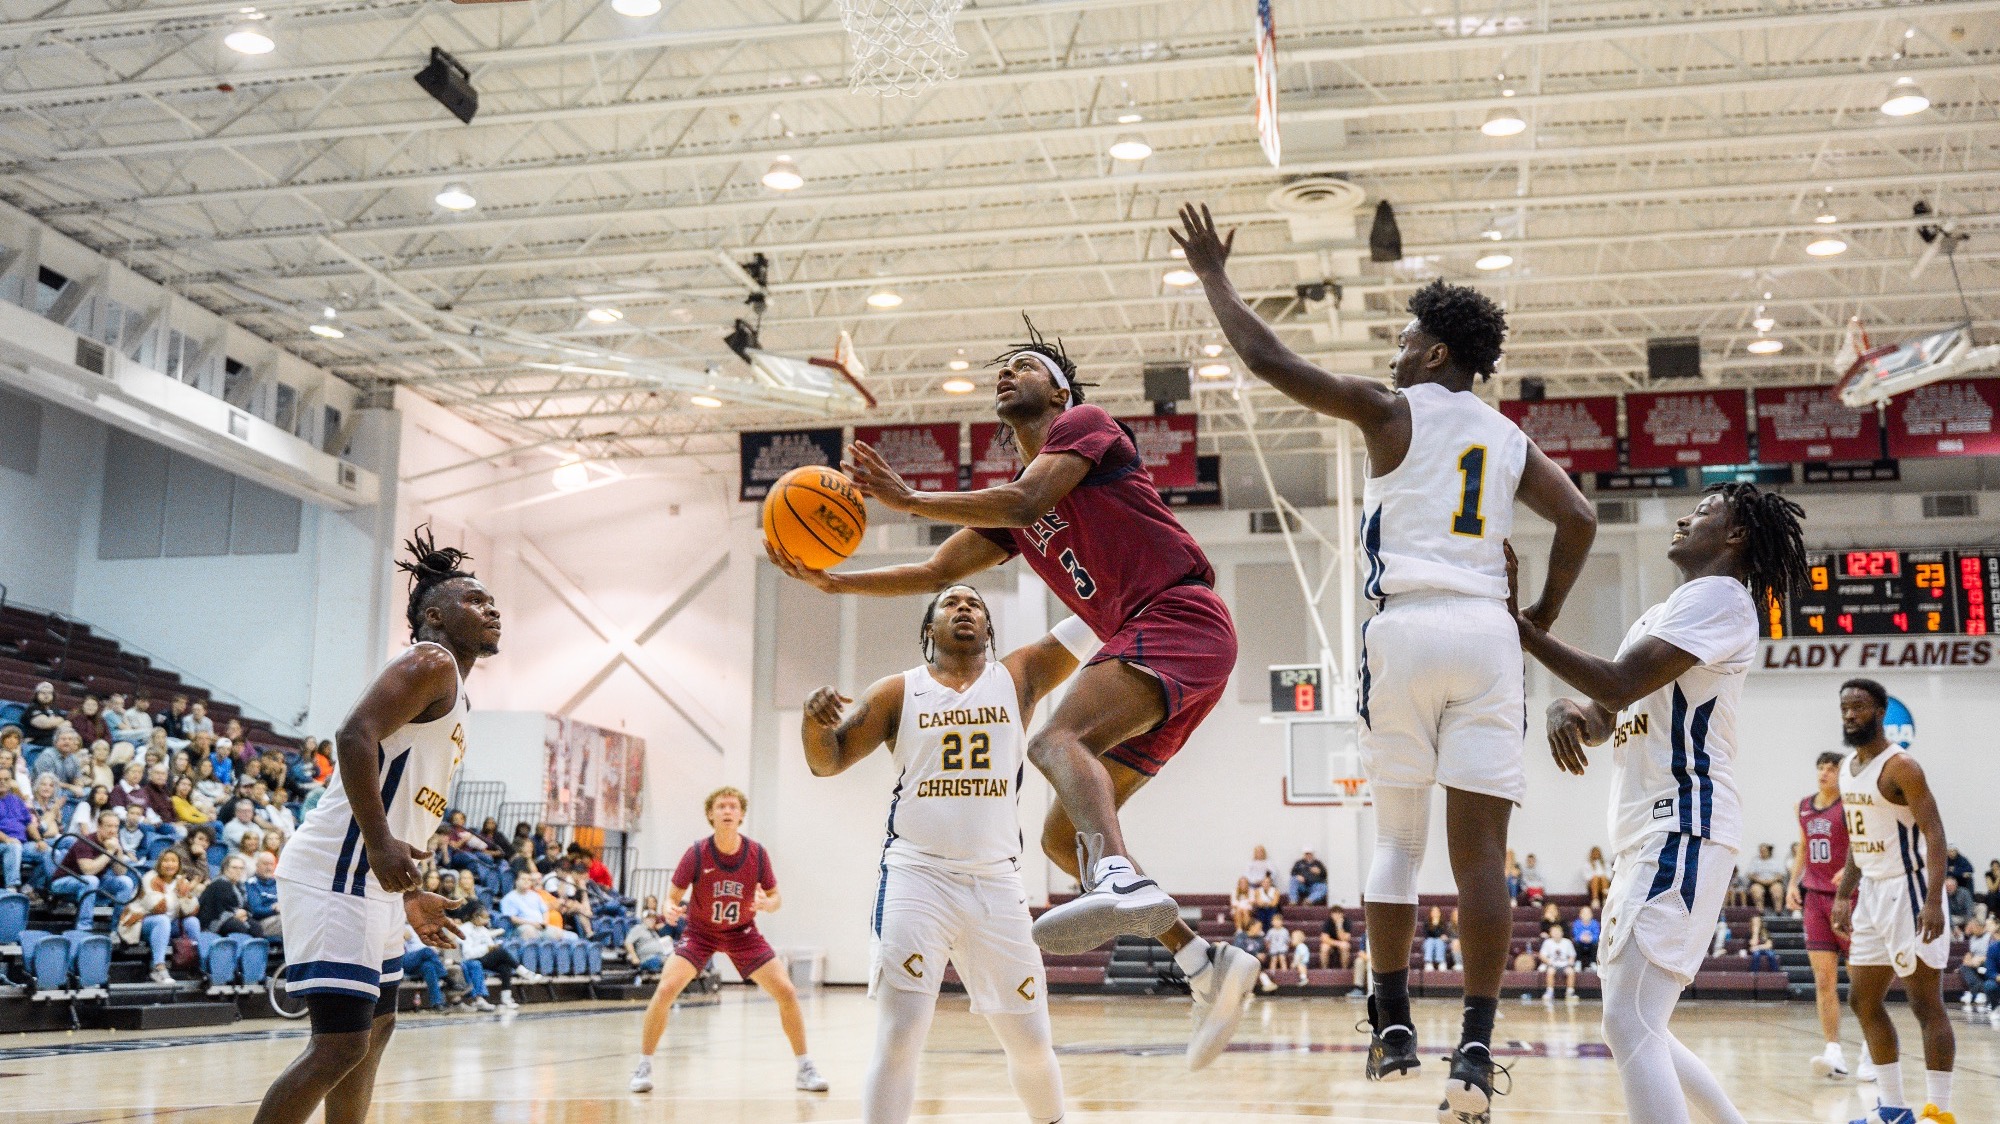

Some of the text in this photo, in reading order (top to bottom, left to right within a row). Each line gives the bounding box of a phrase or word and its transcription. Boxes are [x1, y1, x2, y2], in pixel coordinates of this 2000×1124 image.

[1450, 444, 1487, 539] 1
[1058, 546, 1097, 600] 3
[1915, 563, 1946, 588] 23
[1808, 613, 1825, 634] 4
[1837, 612, 1853, 634] 4
[1893, 612, 1909, 632] 4
[1927, 611, 1941, 632] 2
[1763, 640, 1993, 669] LADY FLAMES
[1296, 684, 1315, 712] 8
[918, 706, 1011, 729] CAROLINA
[942, 730, 991, 771] 22
[917, 777, 1008, 798] CHRISTIAN
[1846, 809, 1865, 835] 12
[1809, 838, 1832, 863] 10
[713, 880, 744, 899] LEE
[712, 901, 740, 925] 14
